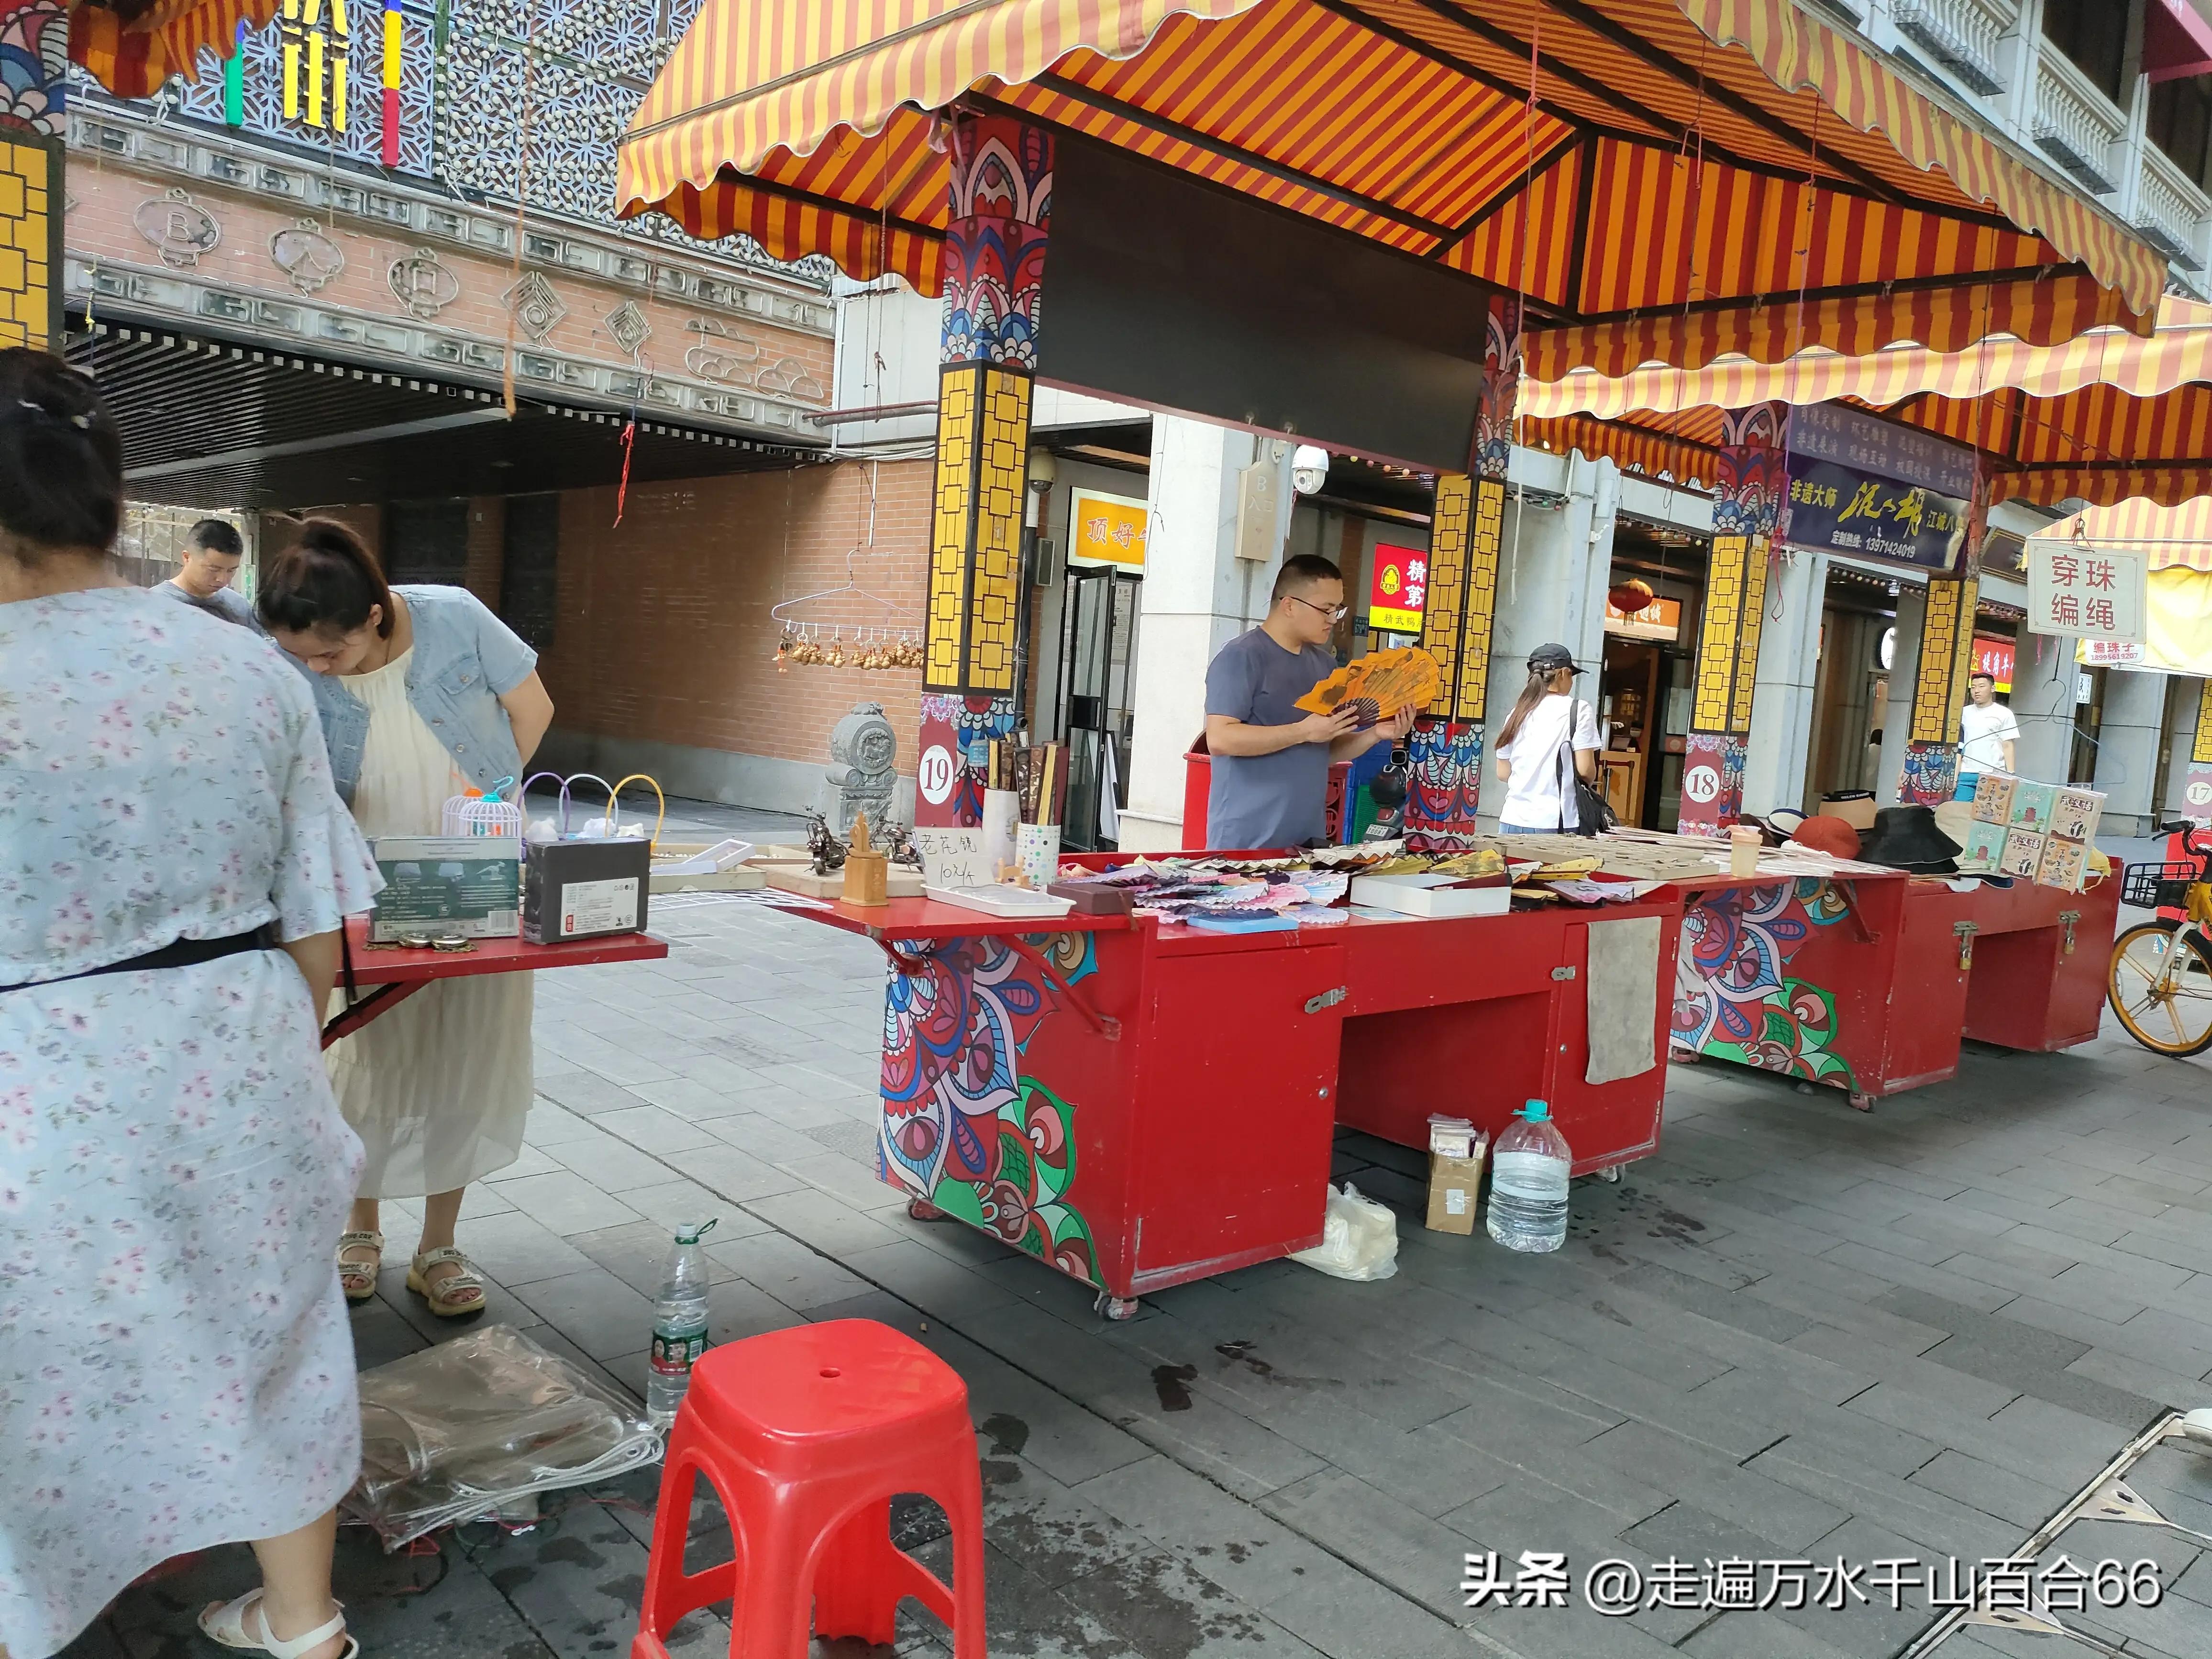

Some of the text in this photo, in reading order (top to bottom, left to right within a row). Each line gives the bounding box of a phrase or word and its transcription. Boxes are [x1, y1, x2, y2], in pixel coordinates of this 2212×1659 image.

[1258, 476, 1267, 491] B
[1790, 479, 1837, 509] 非遗大师
[1249, 496, 1274, 512] 入口
[1866, 537, 1916, 559] 13971424019
[2051, 554, 2116, 592] 穿珠
[2051, 593, 2115, 630] 编绳
[2091, 653, 2138, 661] 18995619207
[924, 757, 949, 791] 19
[1689, 774, 1715, 796] 18
[2190, 786, 2211, 800] 17
[919, 834, 977, 855] 老花镜
